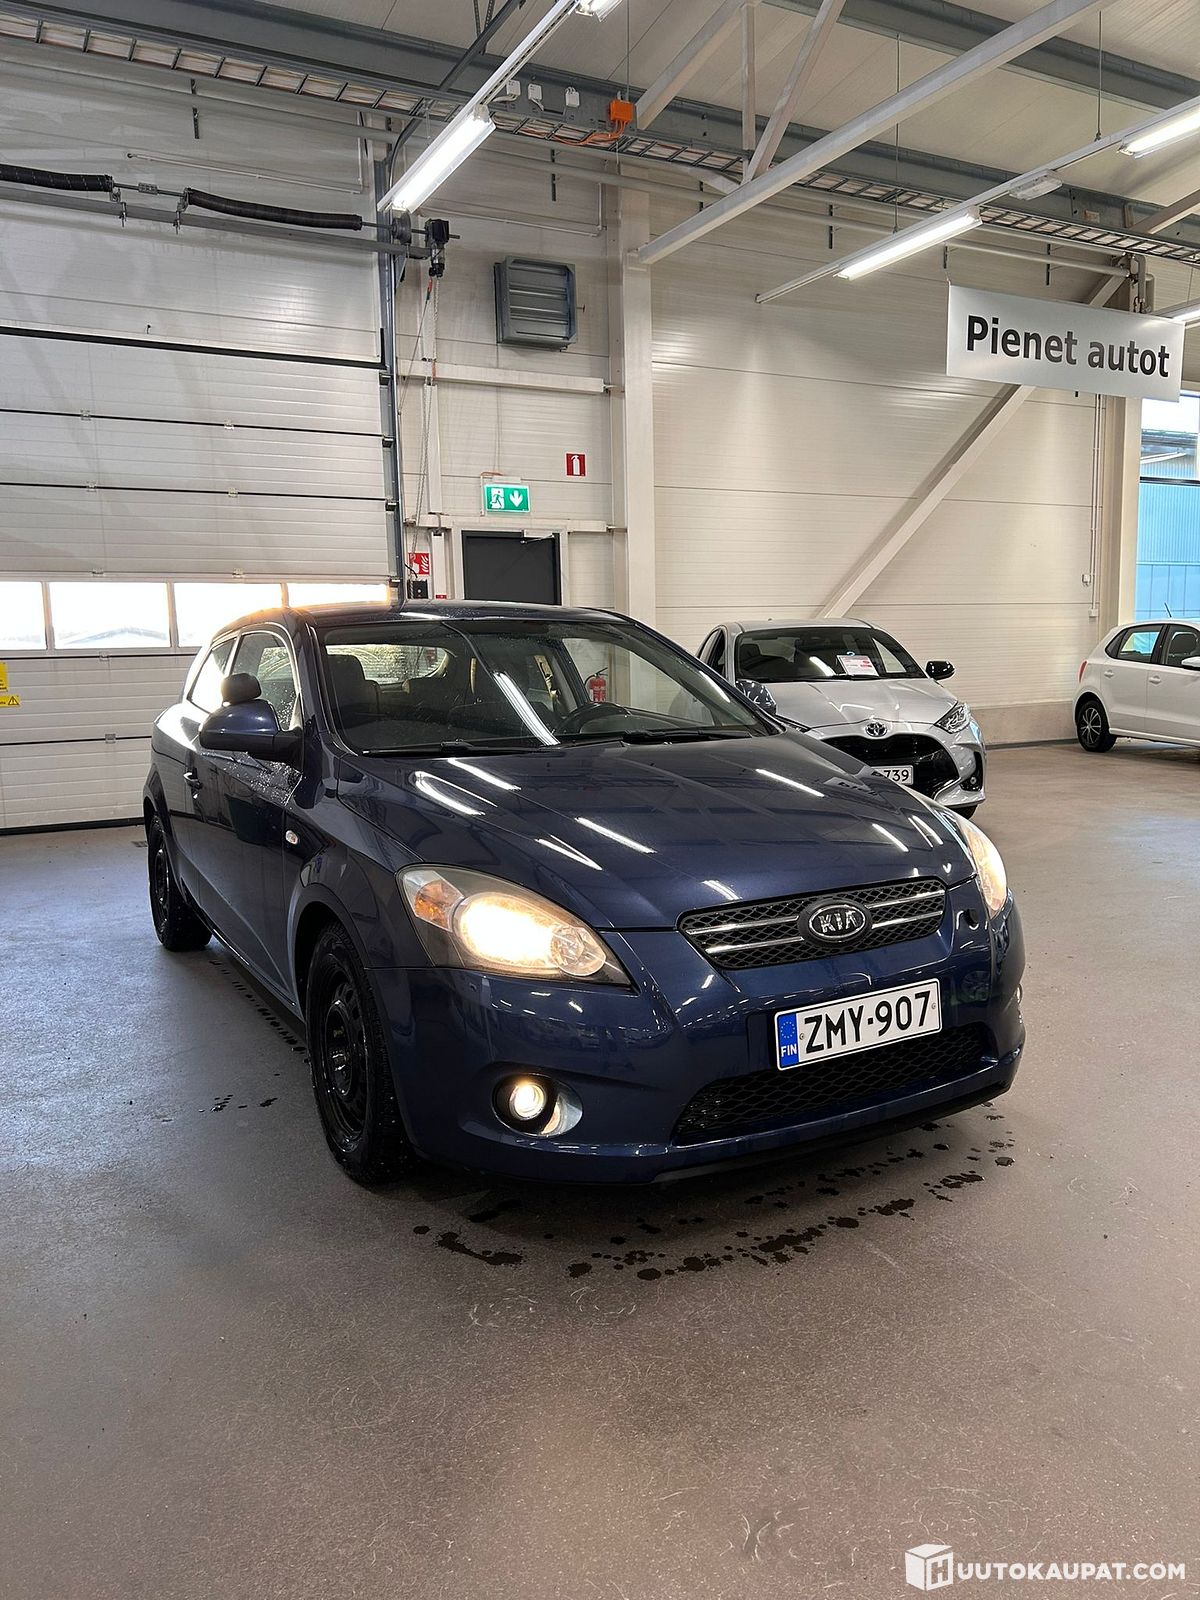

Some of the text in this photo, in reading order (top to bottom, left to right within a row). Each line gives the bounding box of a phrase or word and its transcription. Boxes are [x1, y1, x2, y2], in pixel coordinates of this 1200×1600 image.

[966, 314, 1170, 378] Pienet autot
[818, 910, 858, 933] KIA
[804, 990, 931, 1054] ZMY-907
[780, 1043, 798, 1058] FIN
